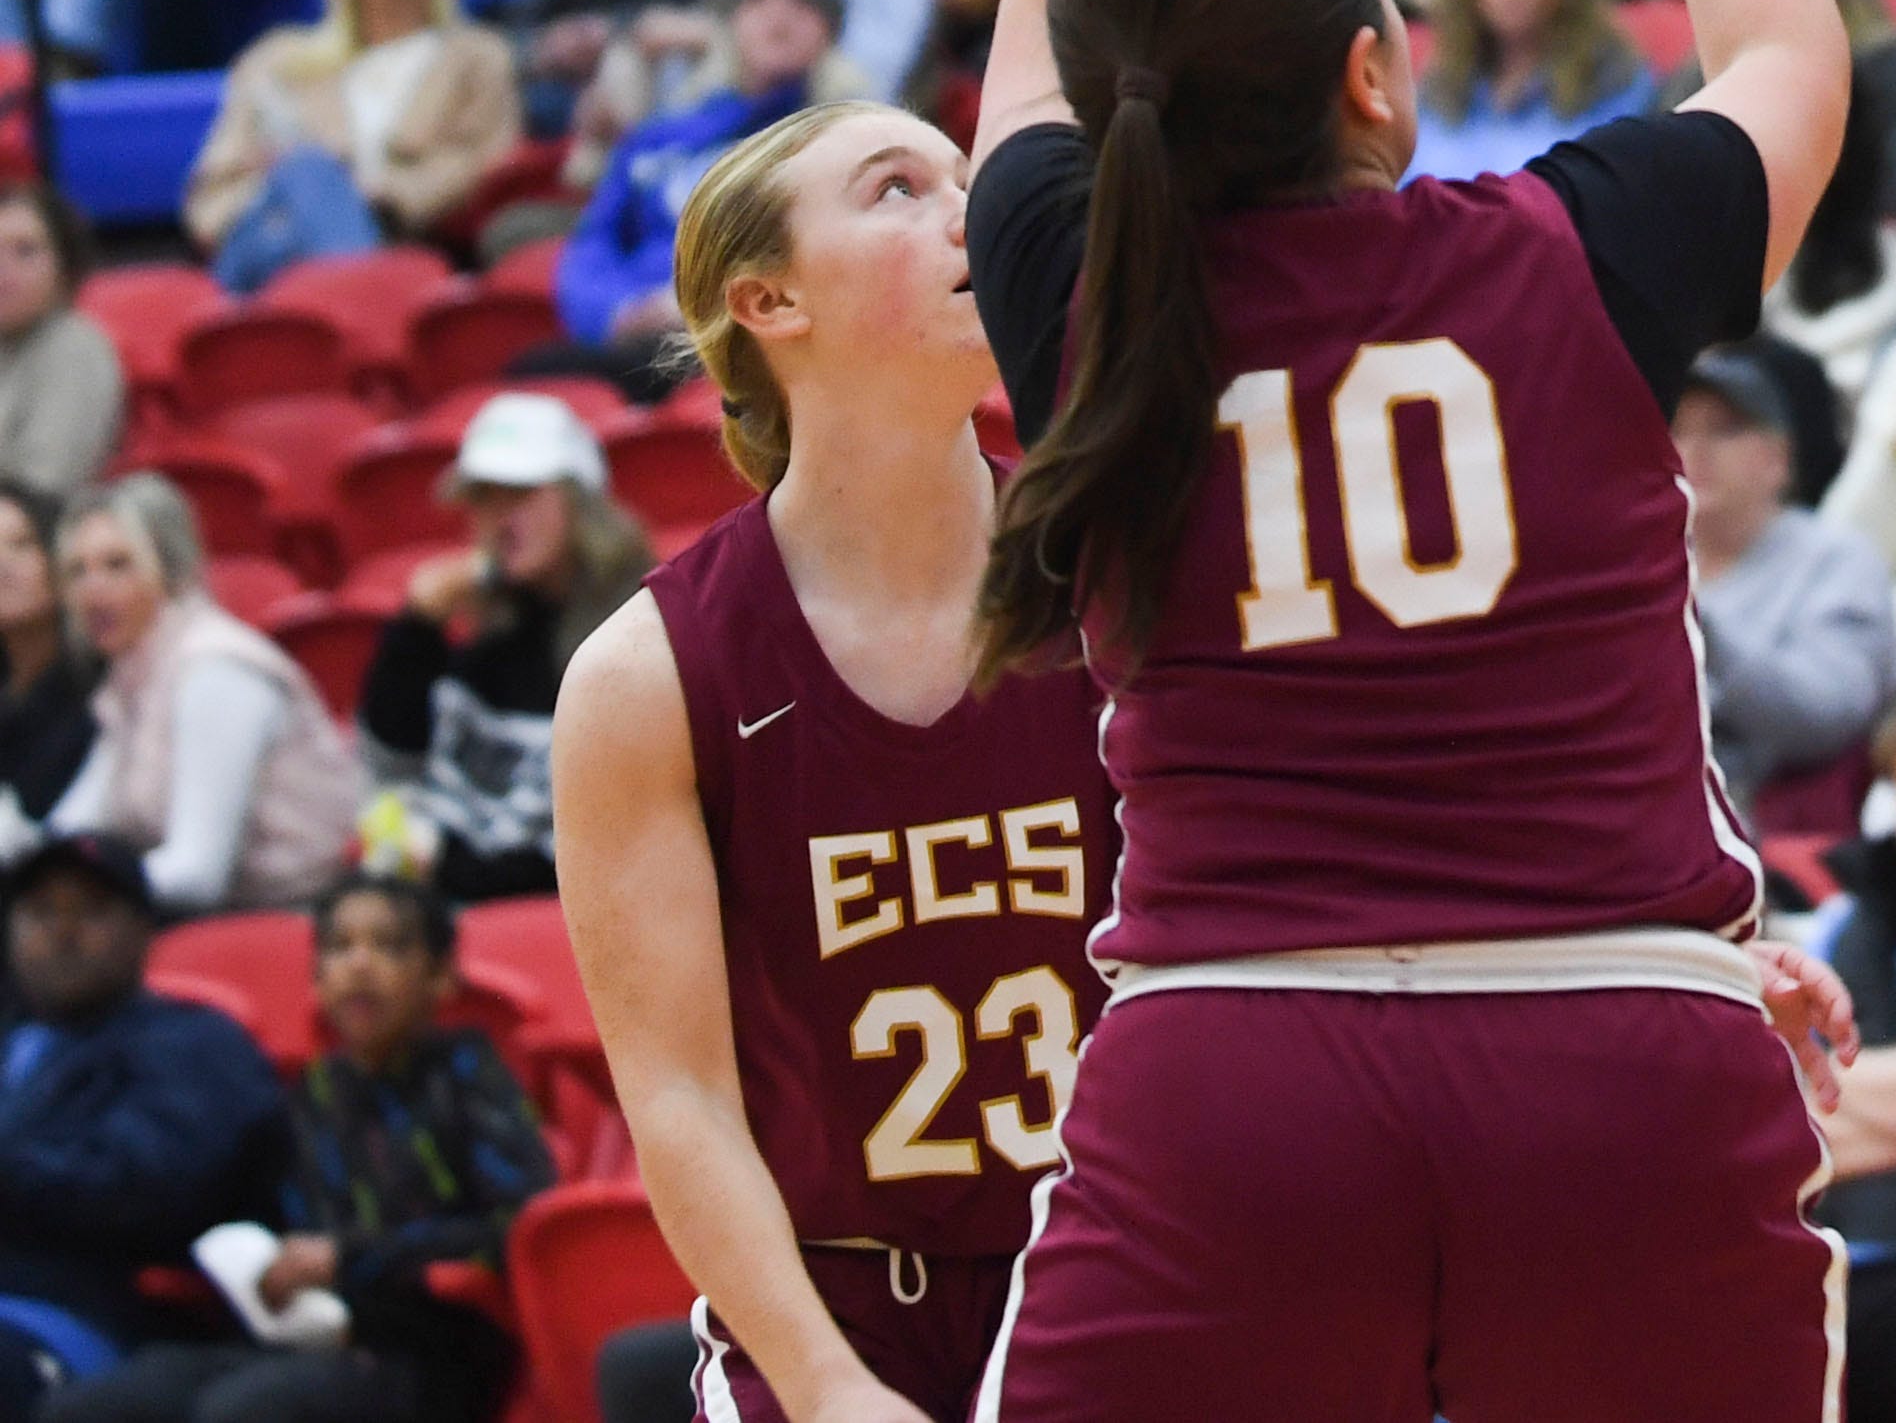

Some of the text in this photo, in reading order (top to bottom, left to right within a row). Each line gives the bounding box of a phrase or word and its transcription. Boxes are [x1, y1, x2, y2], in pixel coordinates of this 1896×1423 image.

[1214, 336, 1521, 653] 10
[808, 796, 1085, 961] ECS
[849, 965, 1079, 1182] 23
